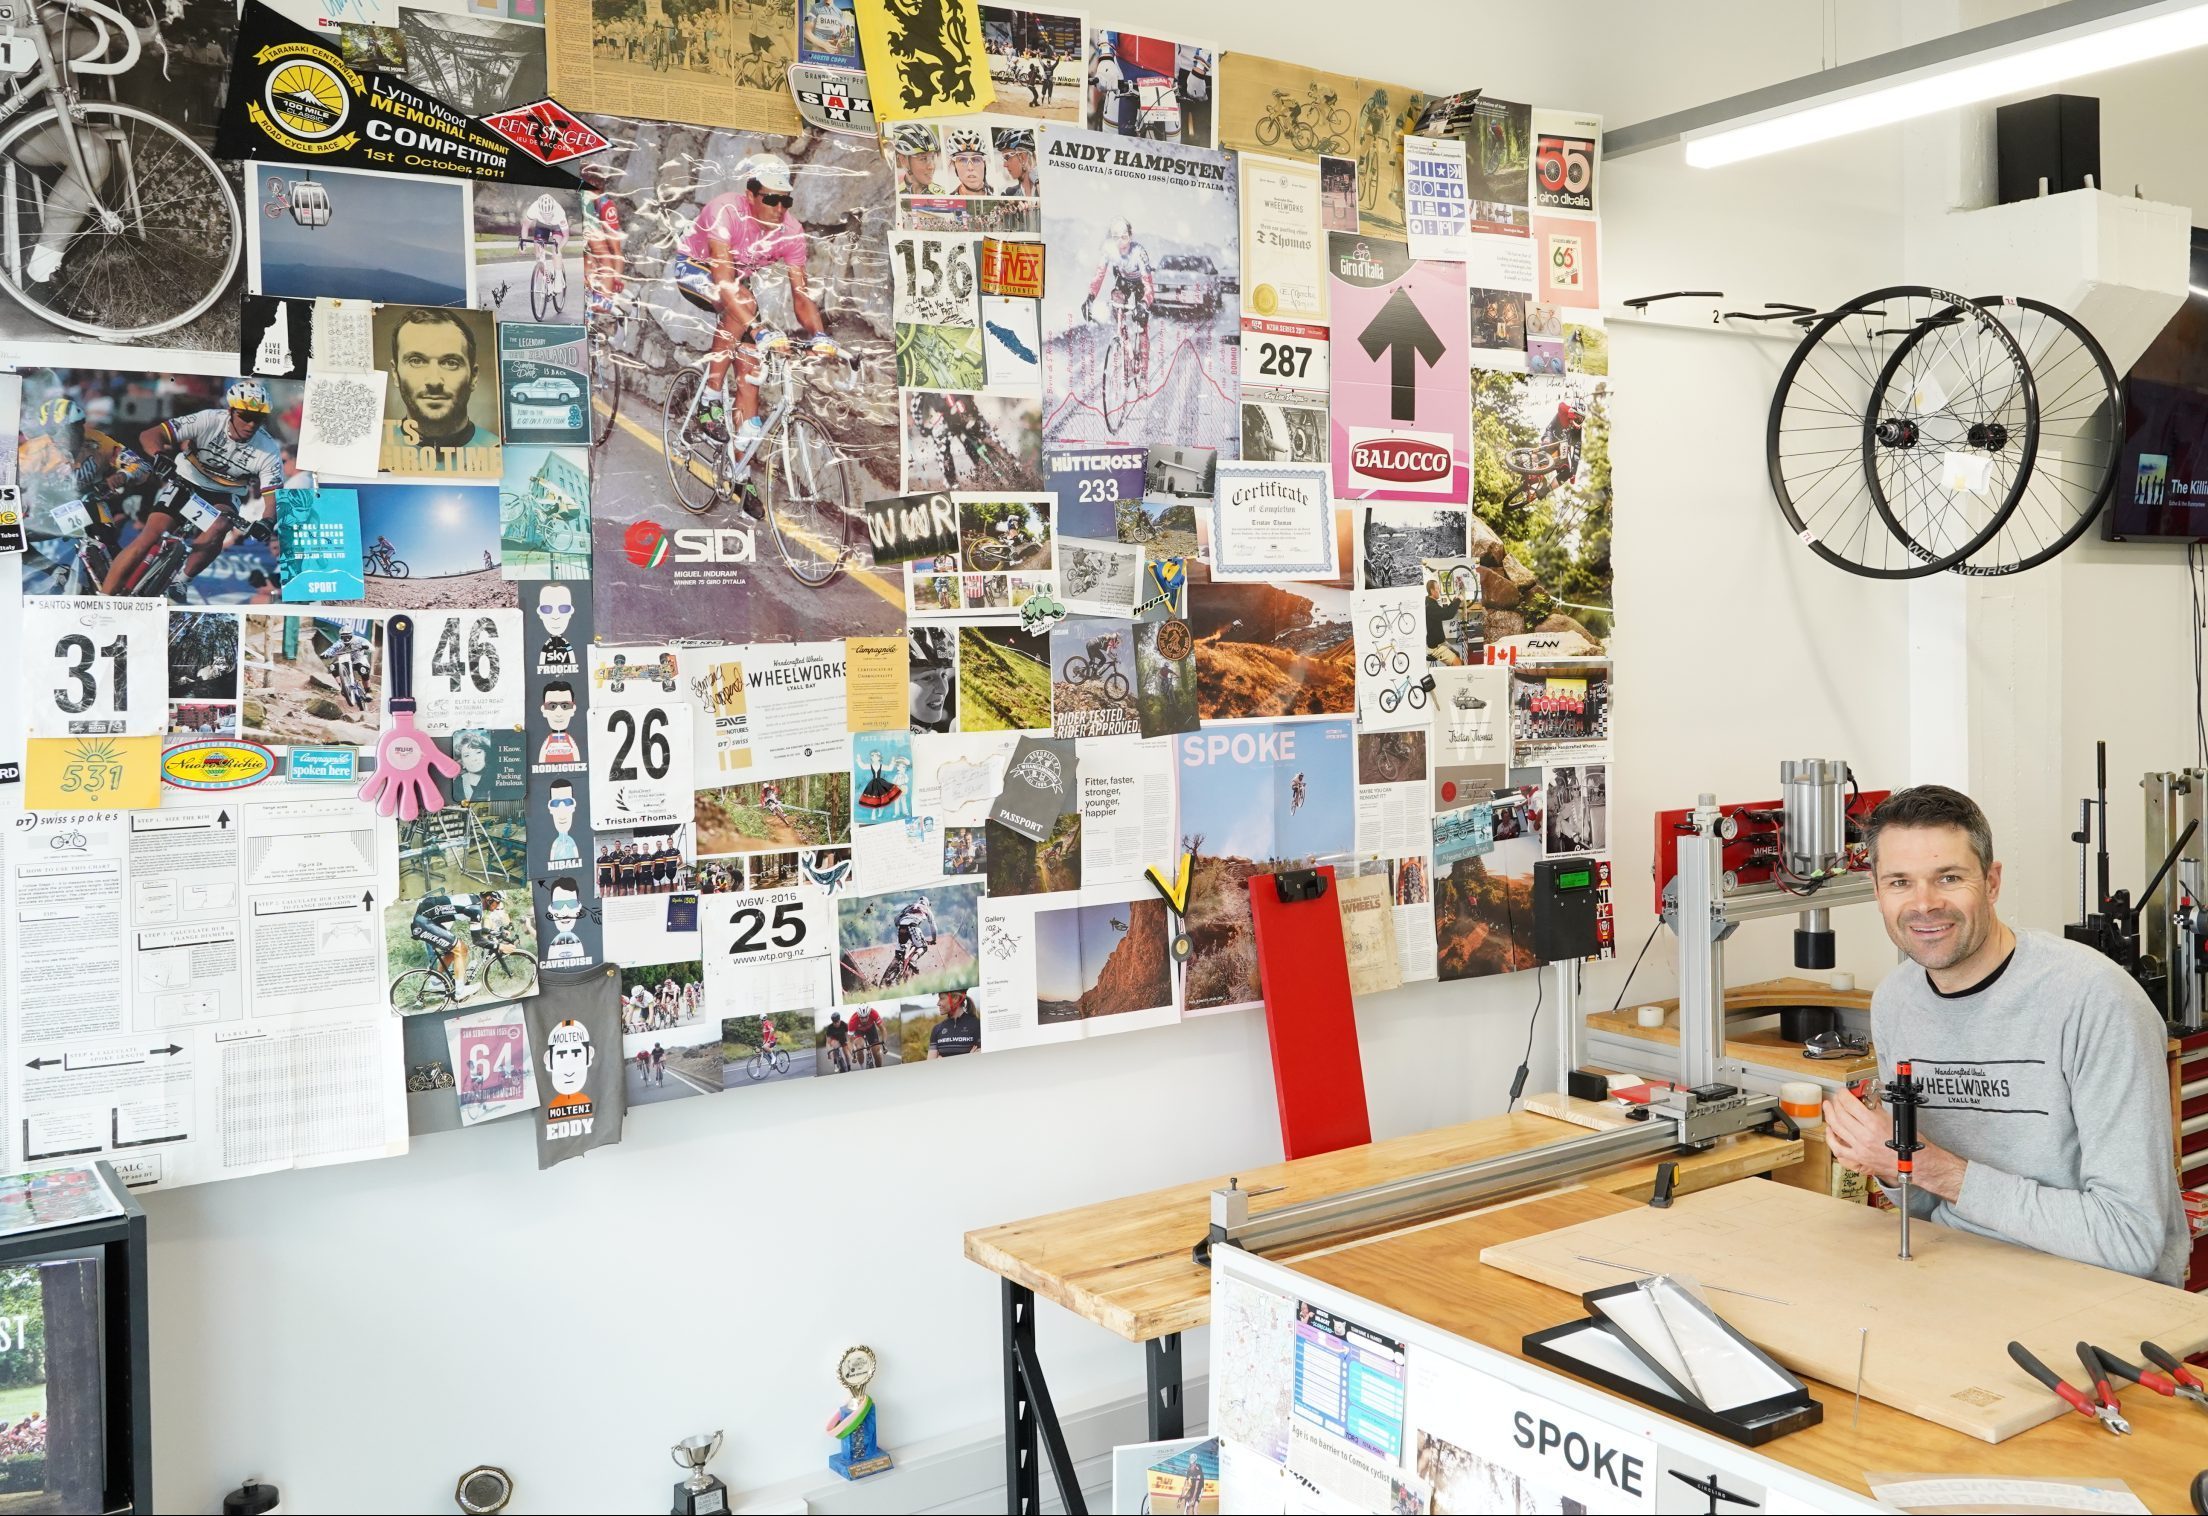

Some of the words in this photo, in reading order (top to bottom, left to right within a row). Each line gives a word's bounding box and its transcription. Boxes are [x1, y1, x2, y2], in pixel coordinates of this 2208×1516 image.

[269, 46, 309, 58] TARANAKI
[312, 48, 356, 85] CENTENNIAL
[283, 100, 304, 111] 100
[305, 106, 330, 119] MILE
[372, 76, 423, 110] Lynn
[427, 102, 466, 128] Wood
[286, 107, 325, 123] CLASSIC
[370, 95, 466, 140] MEMORIAL
[469, 134, 510, 155] PENNANT
[498, 116, 538, 135] RENE
[261, 120, 282, 141] ROAD
[284, 138, 314, 152] CYCLE
[317, 141, 340, 152] RACE
[366, 119, 507, 168] COMPETITOR
[363, 148, 395, 163] 1st
[476, 166, 506, 178] 2011
[1048, 139, 1111, 163] ANDY
[1113, 149, 1226, 181] HAMPSTEN
[1048, 159, 1077, 170] PASSO
[1114, 168, 1146, 180] GIUGNO
[1264, 199, 1305, 214] WHEELWORKS
[896, 239, 974, 299] 156
[1340, 257, 1358, 277] Giro
[1358, 259, 1385, 280] d'Italia
[1713, 310, 1720, 324] 2
[519, 338, 546, 348] LEGENDARY
[1259, 343, 1313, 378] 287
[1052, 453, 1143, 473] HÜTTCROSS
[1354, 449, 1448, 472] BALOCCO
[1078, 478, 1119, 503] 233
[1232, 481, 1309, 506] Certificate
[2171, 480, 2188, 494] The
[674, 570, 702, 578] MIGUEL
[308, 581, 338, 593] SPORT
[39, 600, 71, 610] SANTOS
[73, 600, 111, 611] WOMEN'S
[112, 601, 134, 611] TOUR
[135, 602, 153, 611] 2015
[432, 616, 501, 693] 46
[546, 651, 568, 663] sky
[806, 655, 823, 664] Wheels
[53, 633, 128, 714] 31
[536, 663, 579, 675] FROOME
[748, 661, 847, 688] WHEELWORKS
[1057, 711, 1085, 727] RIDER
[1087, 709, 1125, 723] TESTED.
[726, 727, 749, 735] NOTUBES
[1057, 725, 1086, 739] RIDER
[607, 707, 671, 782] 26
[1183, 731, 1296, 767] SPOKE
[167, 757, 216, 770] Nuovo
[531, 762, 588, 774] RODRIGUEZ
[60, 765, 123, 793] 531
[292, 766, 327, 780] spoken
[328, 766, 351, 777] here
[497, 773, 522, 781] Fucking
[1085, 777, 1109, 786] Fitter,
[1110, 777, 1135, 785] faster,
[1085, 787, 1121, 797] stronger,
[1085, 798, 1120, 808] younger,
[40, 814, 67, 825] swiss
[70, 812, 119, 824] spokes
[605, 816, 638, 826] Tristan
[641, 814, 678, 823] Thomas
[999, 809, 1044, 833] PASSPORT
[1085, 808, 1117, 818] happier
[548, 858, 582, 871] NIBALI
[771, 892, 797, 903] 2016
[1341, 900, 1381, 914] WHEELS
[985, 915, 1006, 924] Gallery
[728, 902, 807, 955] 25
[539, 956, 593, 970] CAVENDISH
[733, 948, 805, 965] www.wtp.org.nz
[552, 1031, 586, 1044] MOLTENI
[469, 1042, 514, 1082] 64
[1934, 1067, 1970, 1078] Handcrafted
[1915, 1076, 2011, 1098] WHEELWORKS
[1970, 1097, 1981, 1105] BAY
[549, 1104, 591, 1119] MOLTENI
[546, 1117, 595, 1141] EDDY
[114, 1162, 144, 1174] CALC
[1292, 1424, 1303, 1438] Age
[1319, 1437, 1340, 1455] barrier
[1349, 1452, 1370, 1472] Comox
[1370, 1463, 1390, 1483] cyclist
[1513, 1410, 1644, 1498] SPOKE
[1697, 1483, 1727, 1499] CIRCLING
